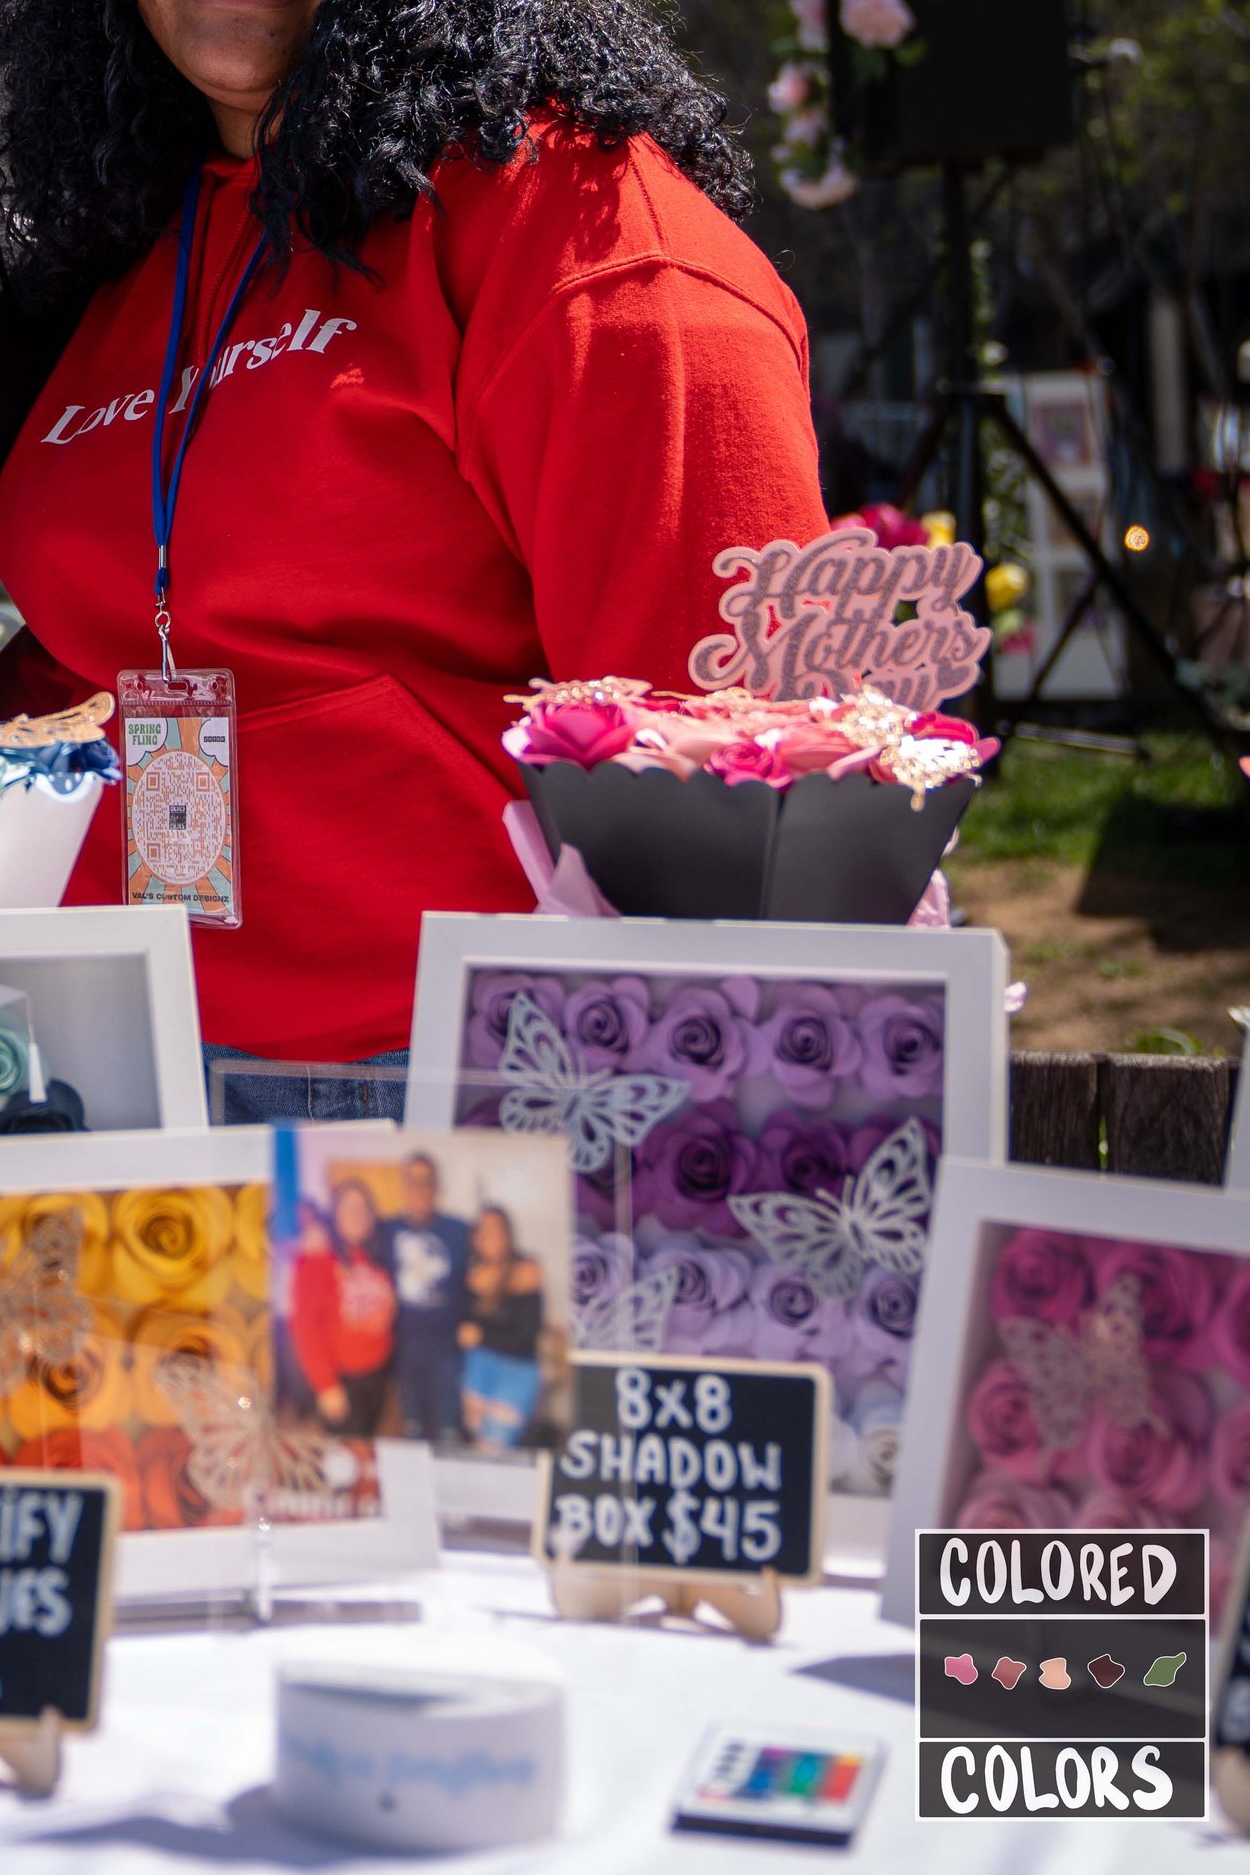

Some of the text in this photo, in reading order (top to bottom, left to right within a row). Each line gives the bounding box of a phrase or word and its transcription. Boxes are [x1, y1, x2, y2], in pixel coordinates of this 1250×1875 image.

[40, 308, 358, 445] Love Yurself
[719, 535, 966, 619] Happy
[694, 608, 974, 688] Mothers
[128, 723, 162, 735] SPRING
[132, 734, 158, 745] FLING
[156, 893, 191, 901] CUSTOM
[559, 1430, 783, 1492] SHADOW
[553, 1488, 782, 1565] BOX $45
